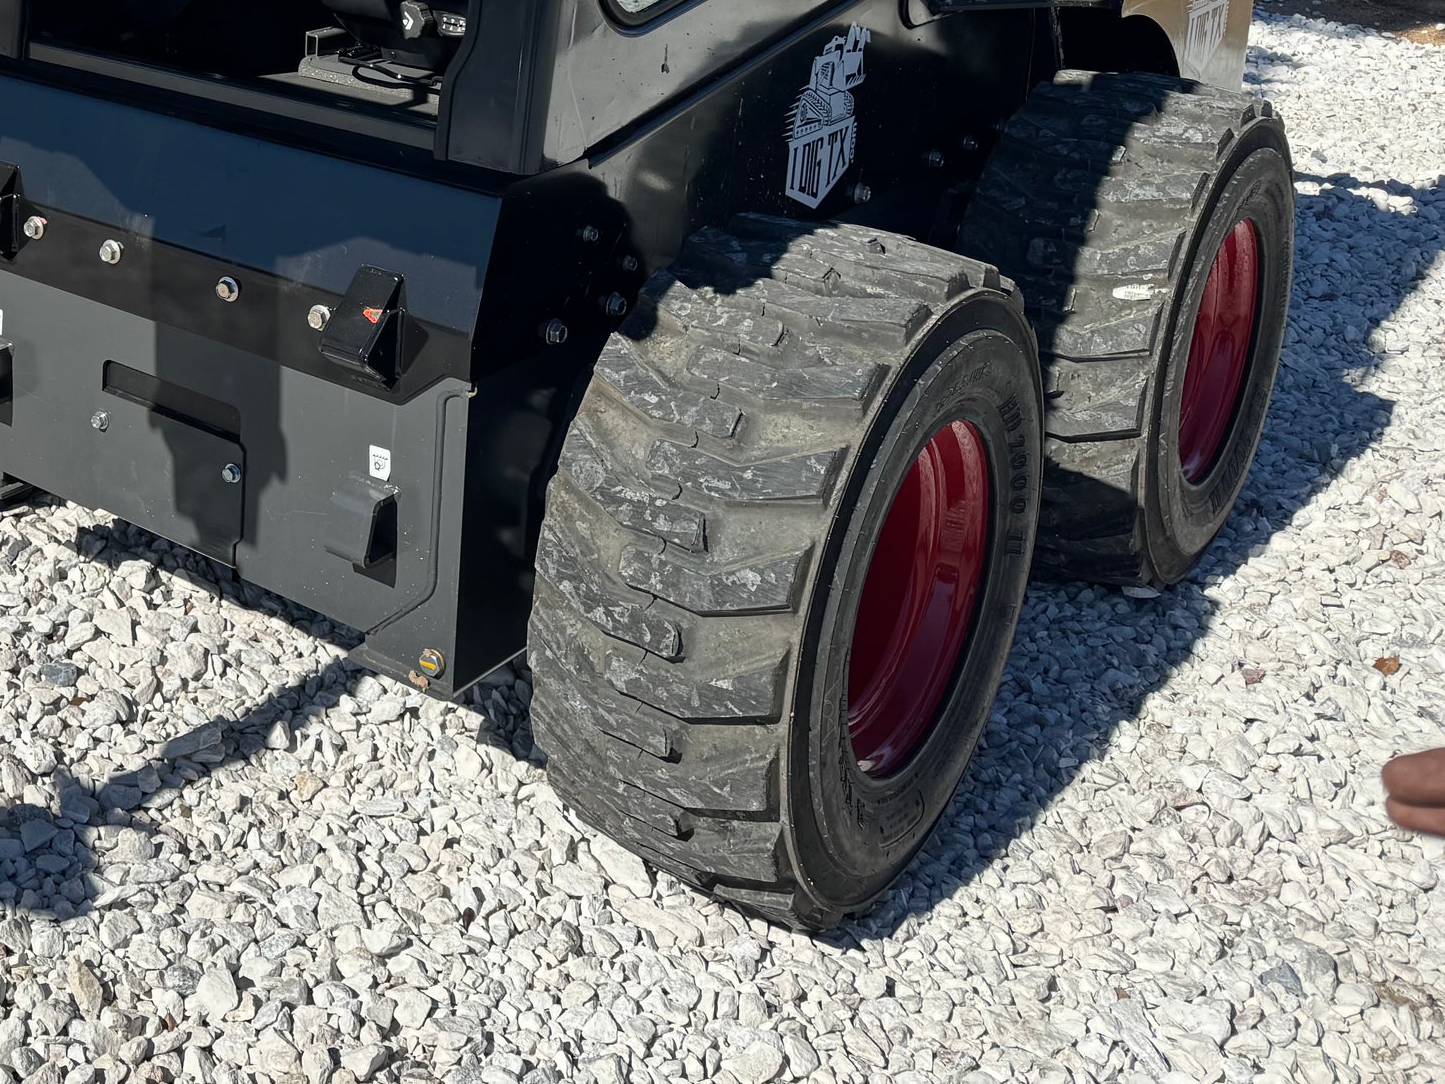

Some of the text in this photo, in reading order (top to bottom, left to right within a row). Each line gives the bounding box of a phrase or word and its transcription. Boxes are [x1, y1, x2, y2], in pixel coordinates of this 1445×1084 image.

[789, 125, 850, 200] I DIG TX
